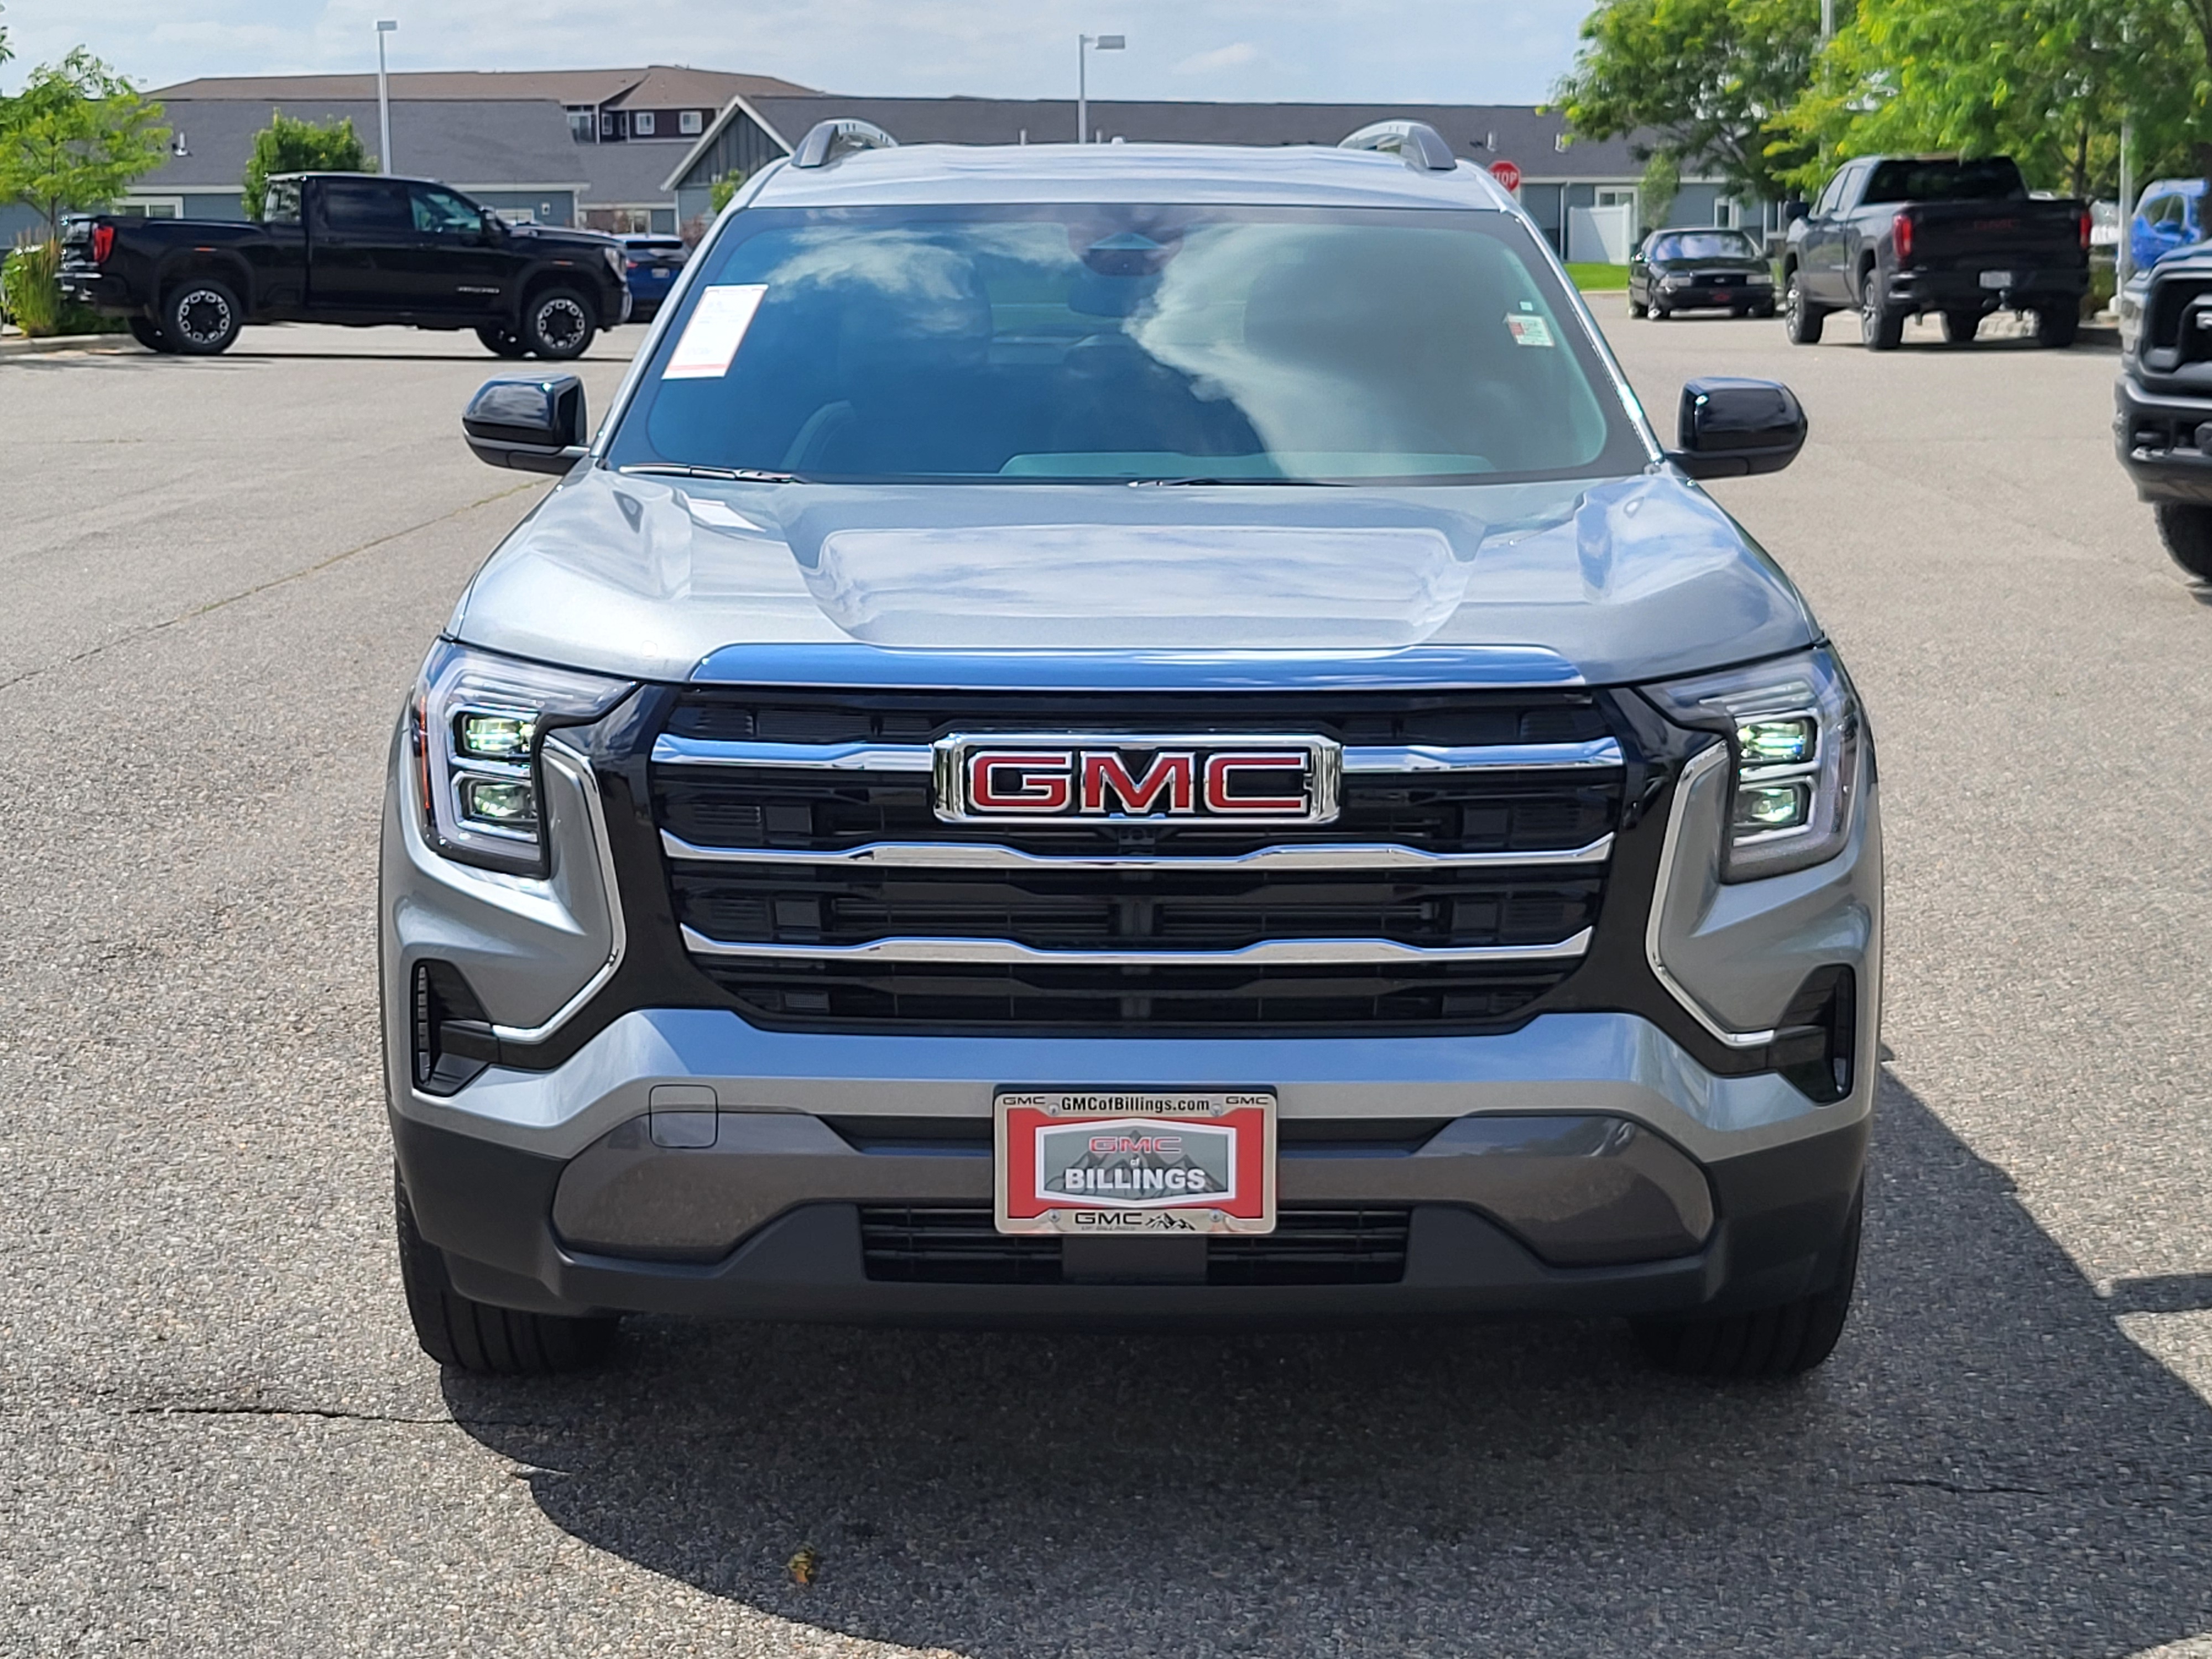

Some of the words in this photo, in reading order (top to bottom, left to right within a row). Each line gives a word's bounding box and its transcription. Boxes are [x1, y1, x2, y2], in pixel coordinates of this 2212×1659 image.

[1491, 171, 1517, 186] TOP
[968, 752, 1307, 813] GMC
[1003, 1097, 1046, 1105] GMC
[1061, 1097, 1210, 1113] GMCofBillings.com
[1225, 1096, 1269, 1105] GMC
[1089, 1136, 1182, 1153] GMC
[1065, 1167, 1206, 1190] BILLINGS
[1075, 1212, 1142, 1225] GMC
